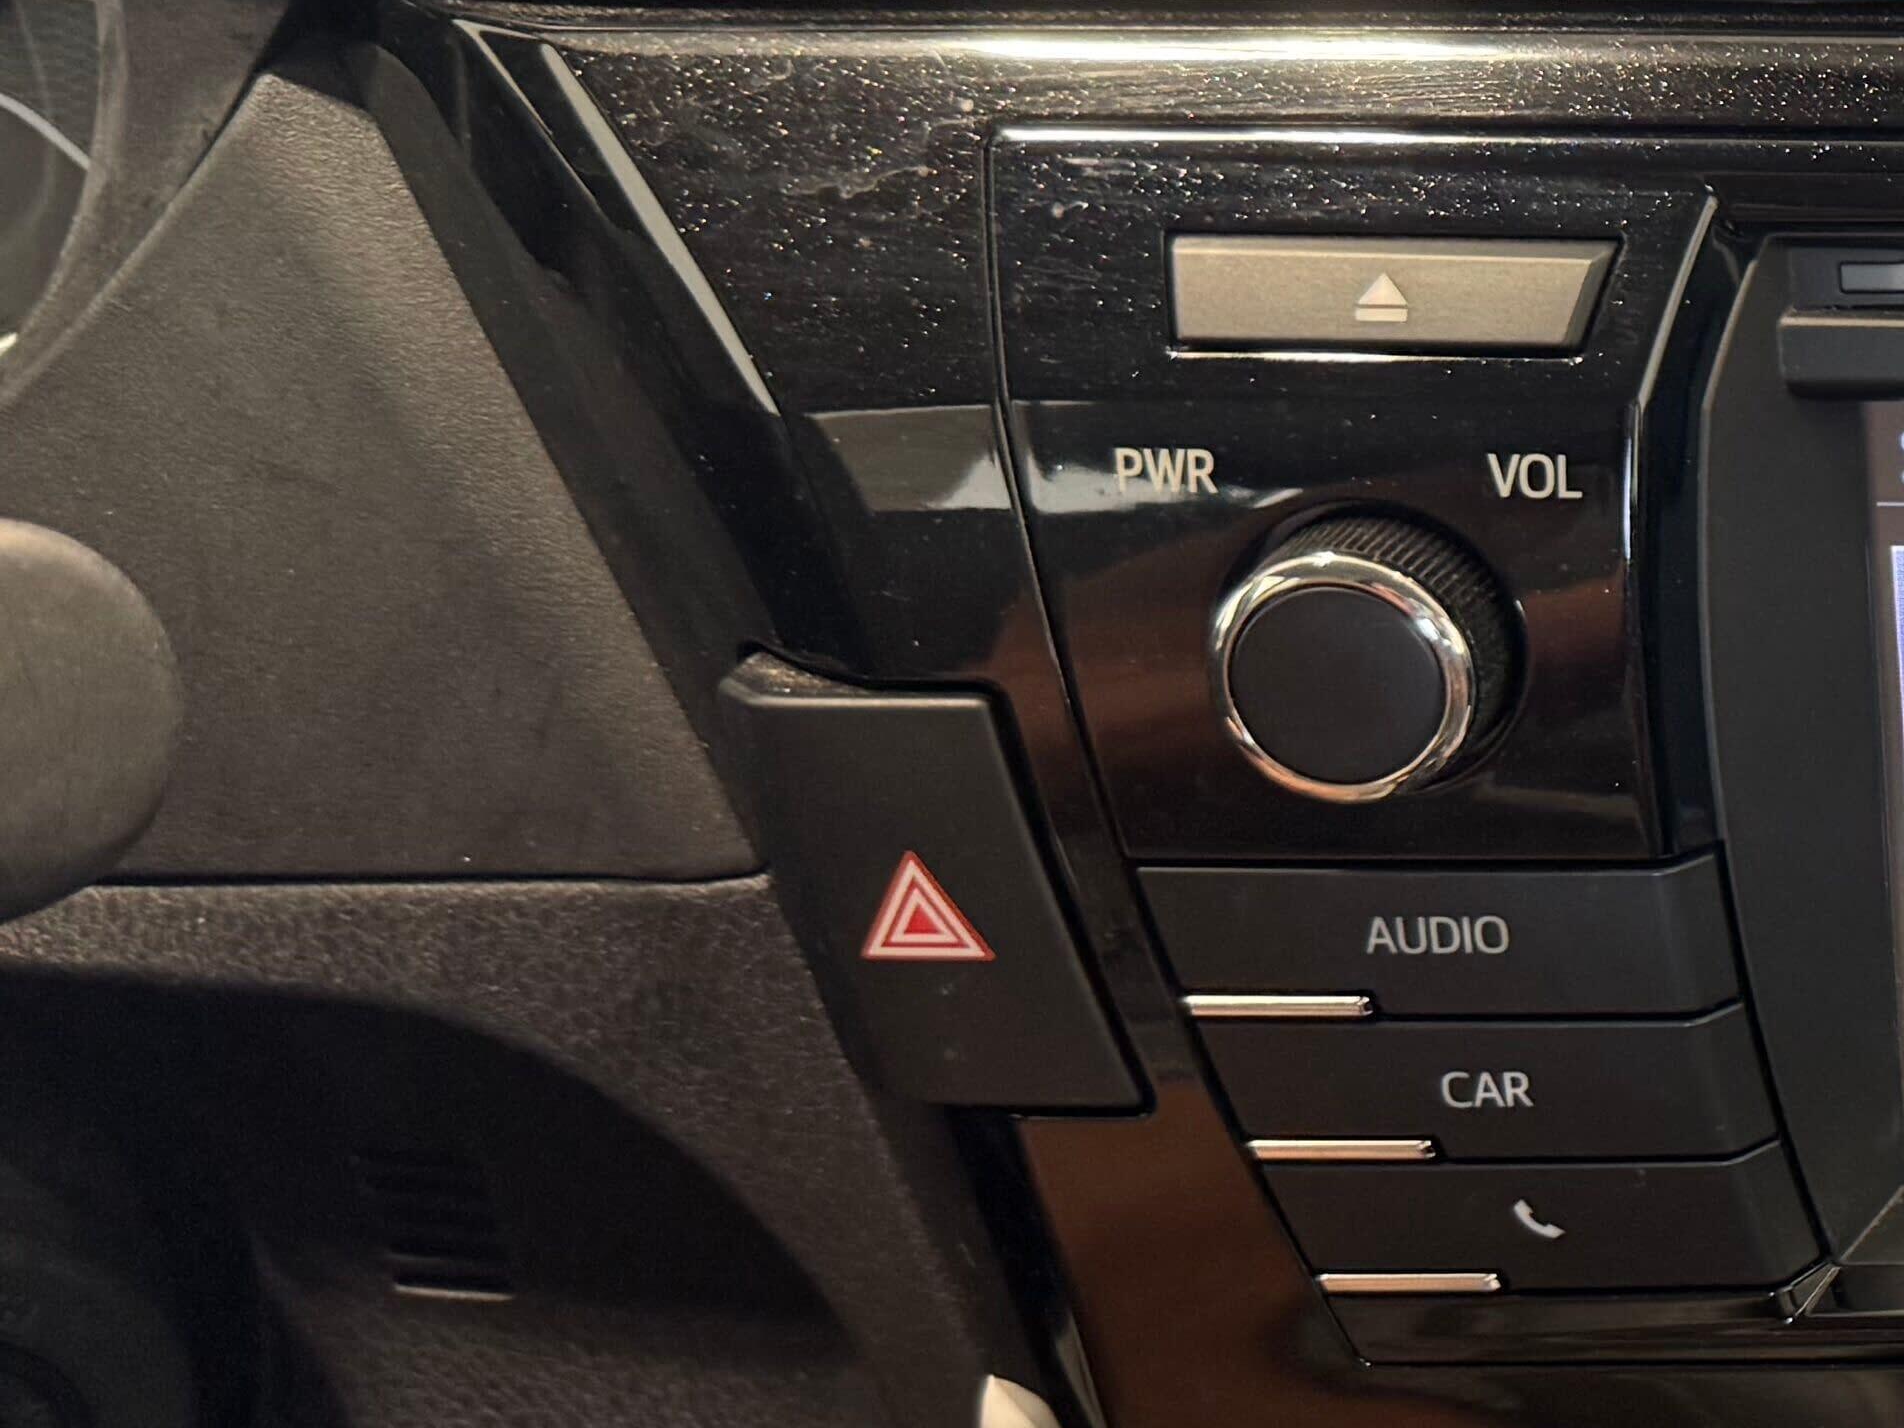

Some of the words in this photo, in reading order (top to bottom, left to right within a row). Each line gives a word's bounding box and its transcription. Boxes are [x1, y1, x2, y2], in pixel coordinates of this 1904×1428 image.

[1113, 447, 1219, 495] PWR
[1487, 452, 1583, 501] VOL
[1366, 915, 1511, 955] AUDIO
[1440, 1070, 1534, 1110] CAR
